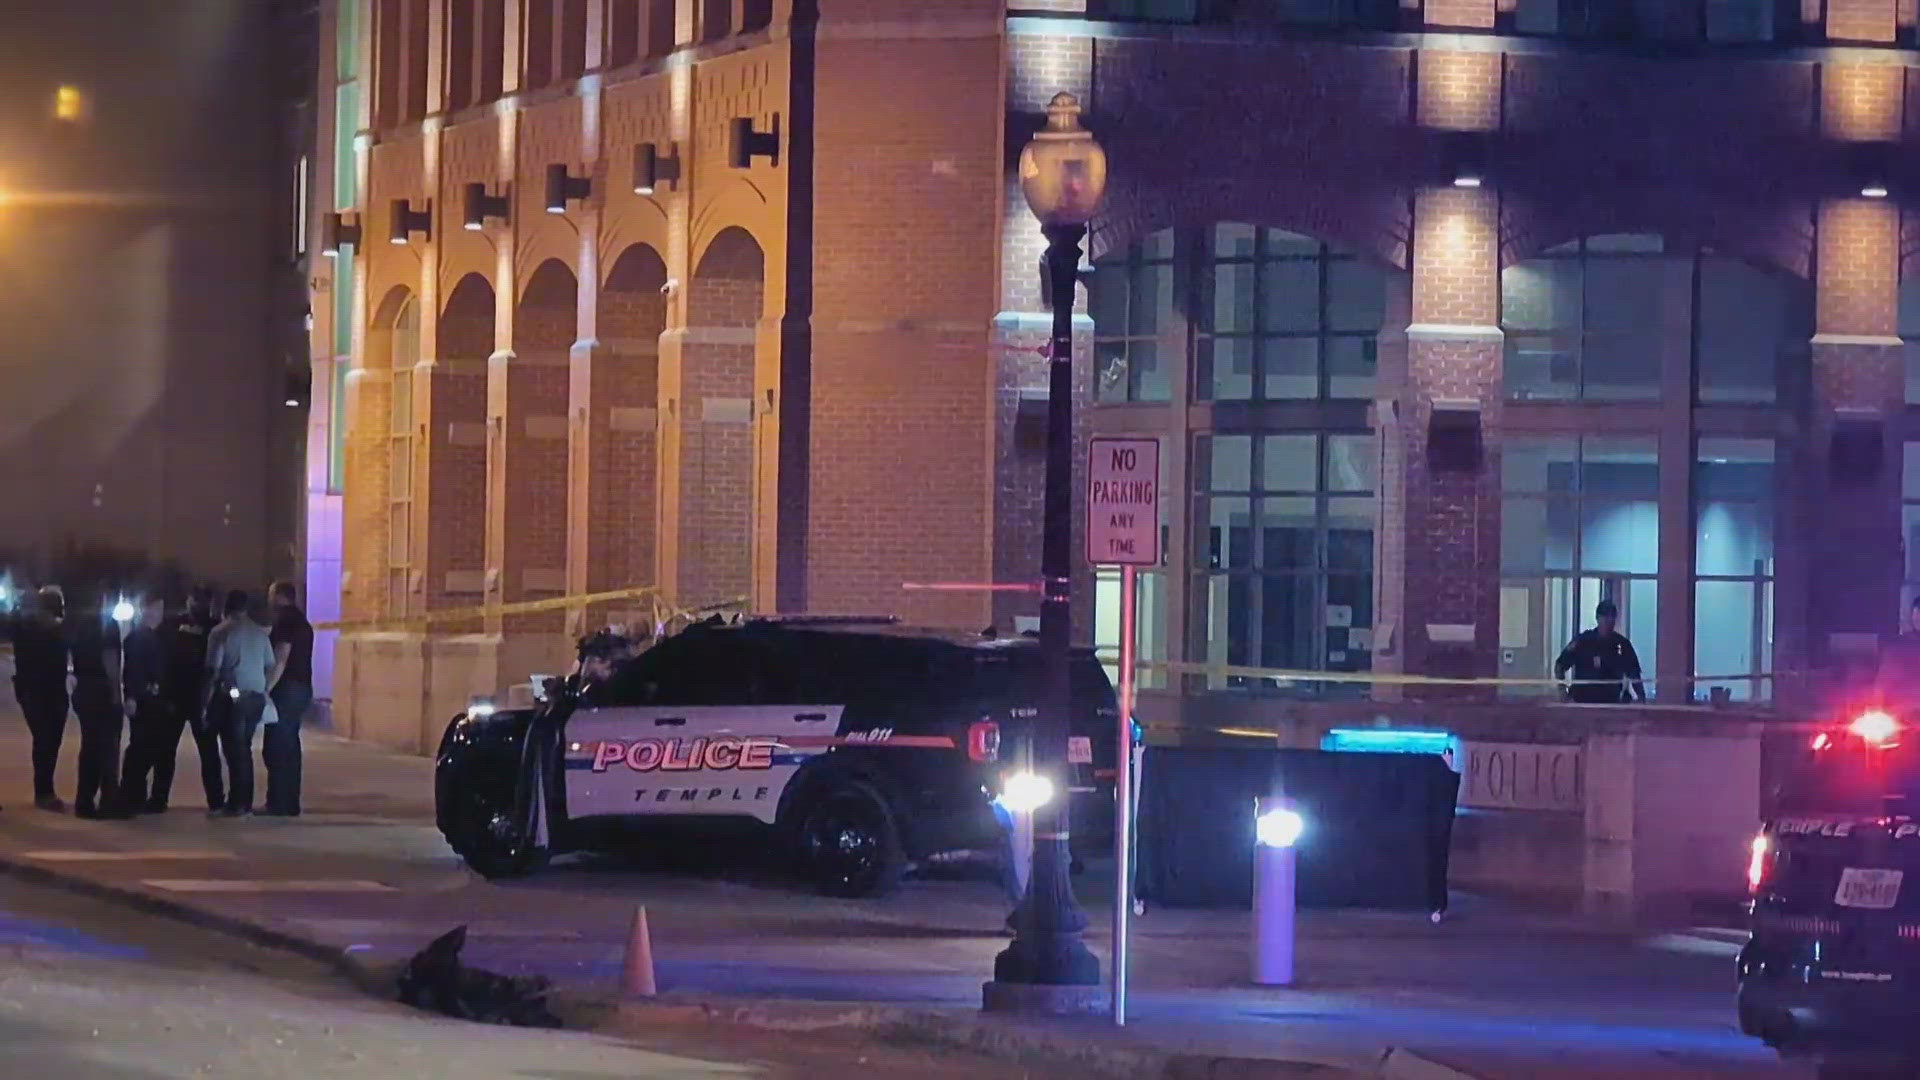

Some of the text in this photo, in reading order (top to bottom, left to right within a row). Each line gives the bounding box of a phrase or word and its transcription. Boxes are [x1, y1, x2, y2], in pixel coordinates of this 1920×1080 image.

[1111, 449, 1136, 471] NO
[1093, 481, 1152, 505] PARKING
[1110, 513, 1134, 529] ANY
[1109, 539, 1135, 554] TIME
[592, 736, 778, 773] POLICE
[635, 787, 769, 801] TEMPLE
